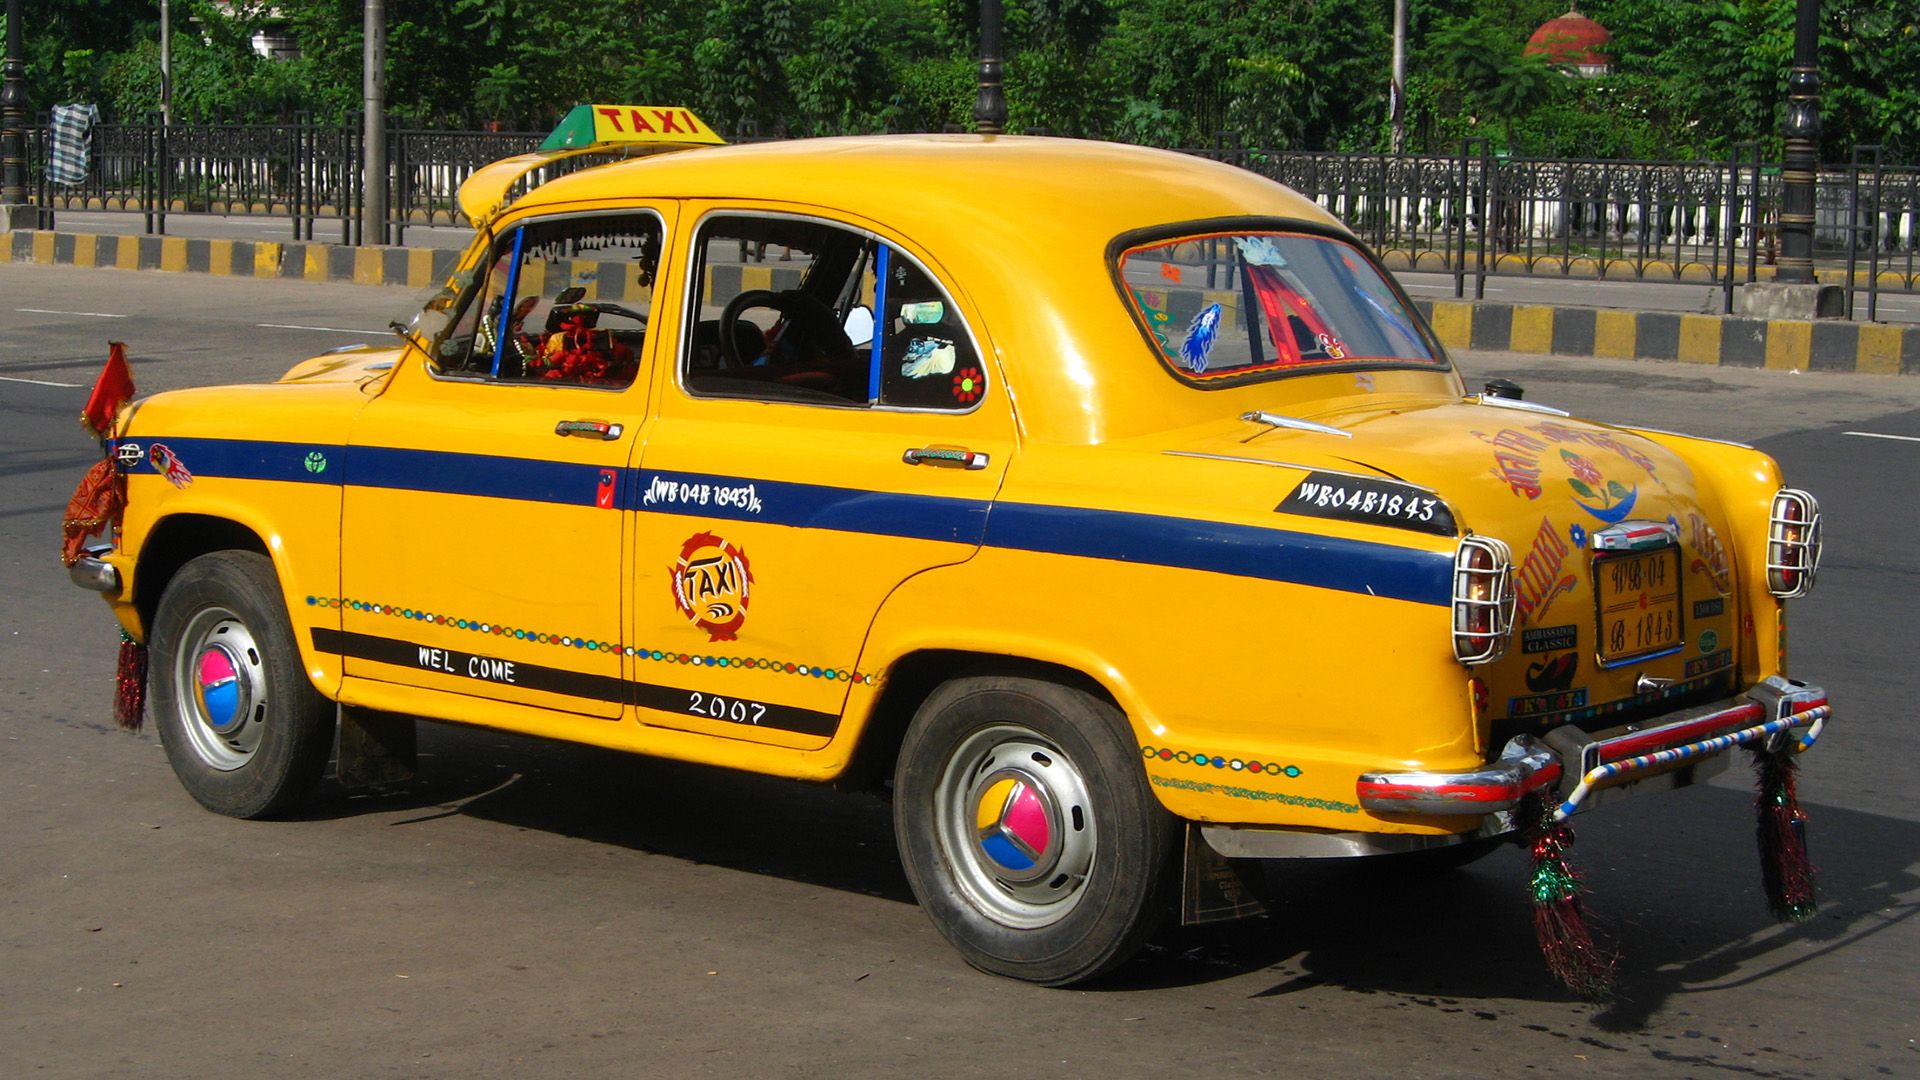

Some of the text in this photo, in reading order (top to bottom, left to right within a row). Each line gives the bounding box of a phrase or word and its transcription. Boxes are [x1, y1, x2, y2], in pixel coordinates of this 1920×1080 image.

[598, 109, 698, 133] TAXI
[684, 556, 738, 605] TAXI
[1527, 637, 1573, 652] CLASSIC
[418, 646, 515, 683] WEL COME
[688, 692, 767, 724] 2007
